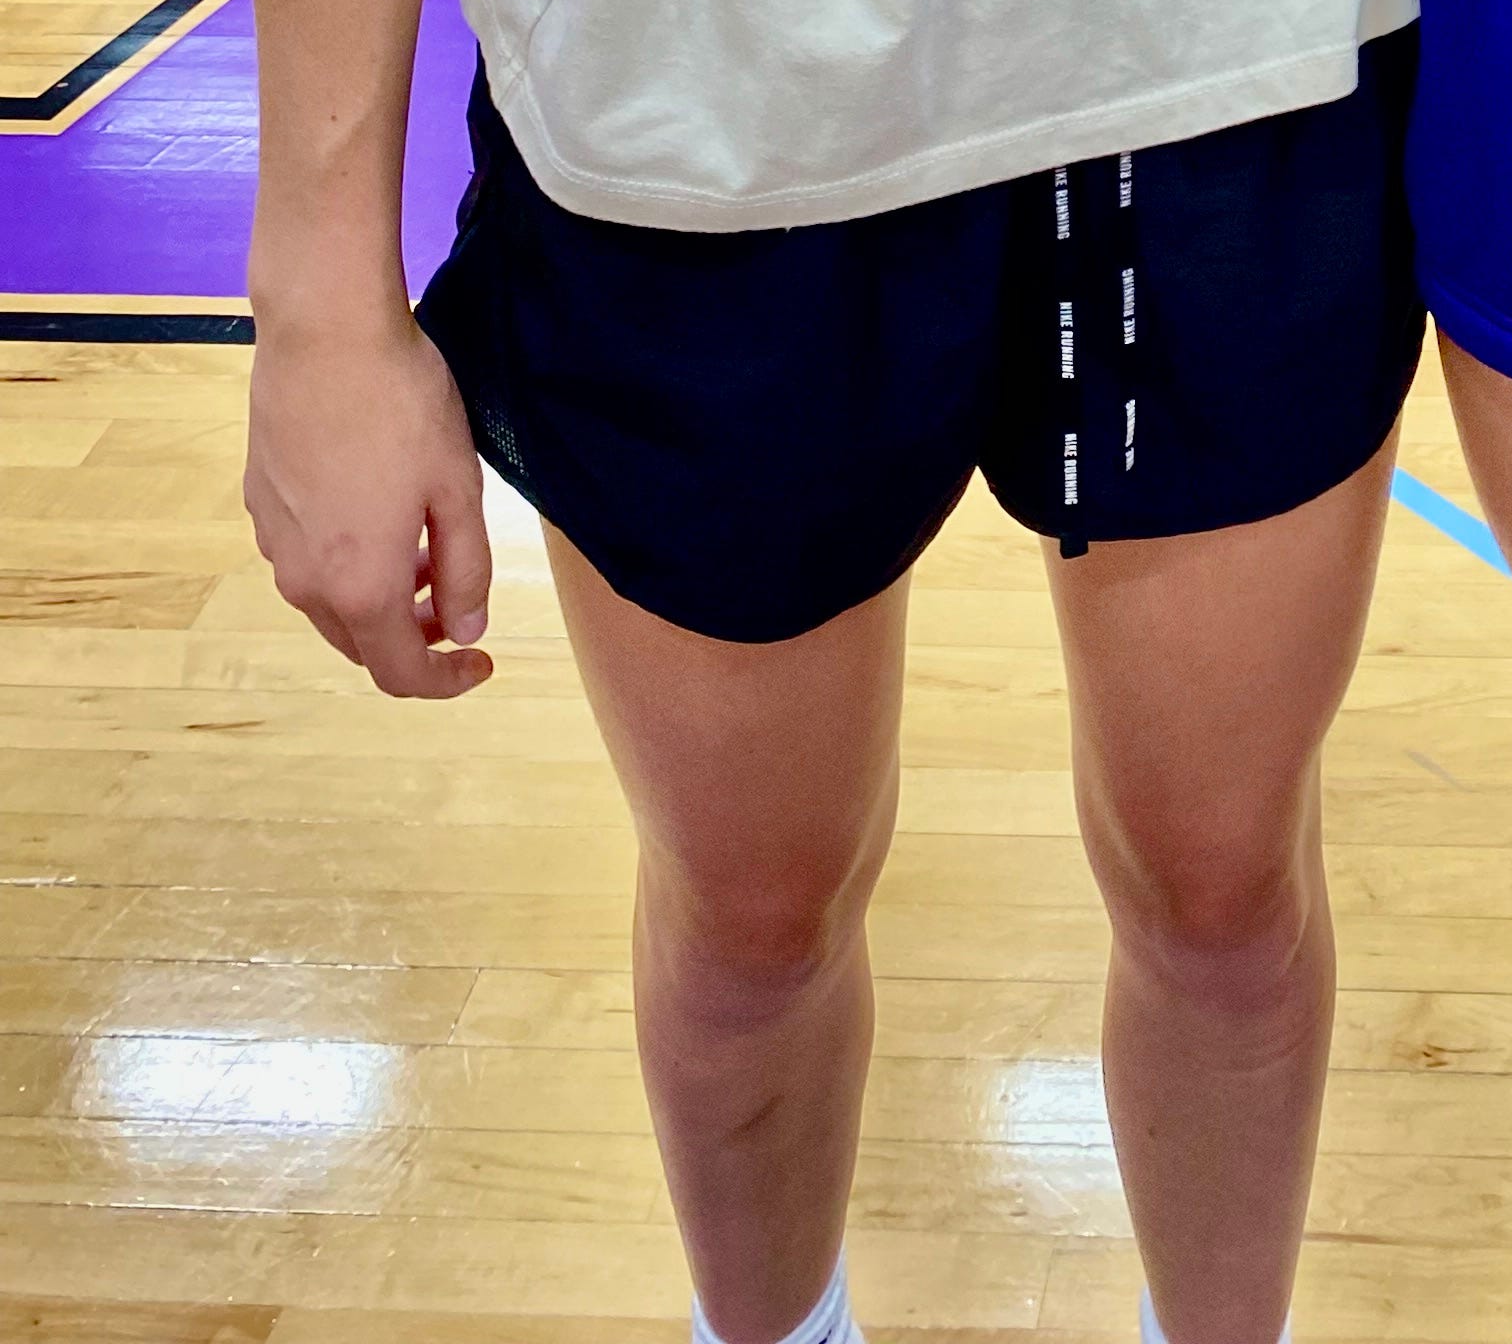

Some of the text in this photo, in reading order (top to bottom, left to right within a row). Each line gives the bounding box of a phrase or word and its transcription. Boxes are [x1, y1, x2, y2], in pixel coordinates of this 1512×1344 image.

[1055, 168, 1070, 240] IKE RUNNING
[1059, 301, 1075, 379] NIKE RUNNING
[1064, 433, 1079, 505] NIKE RUNNING
